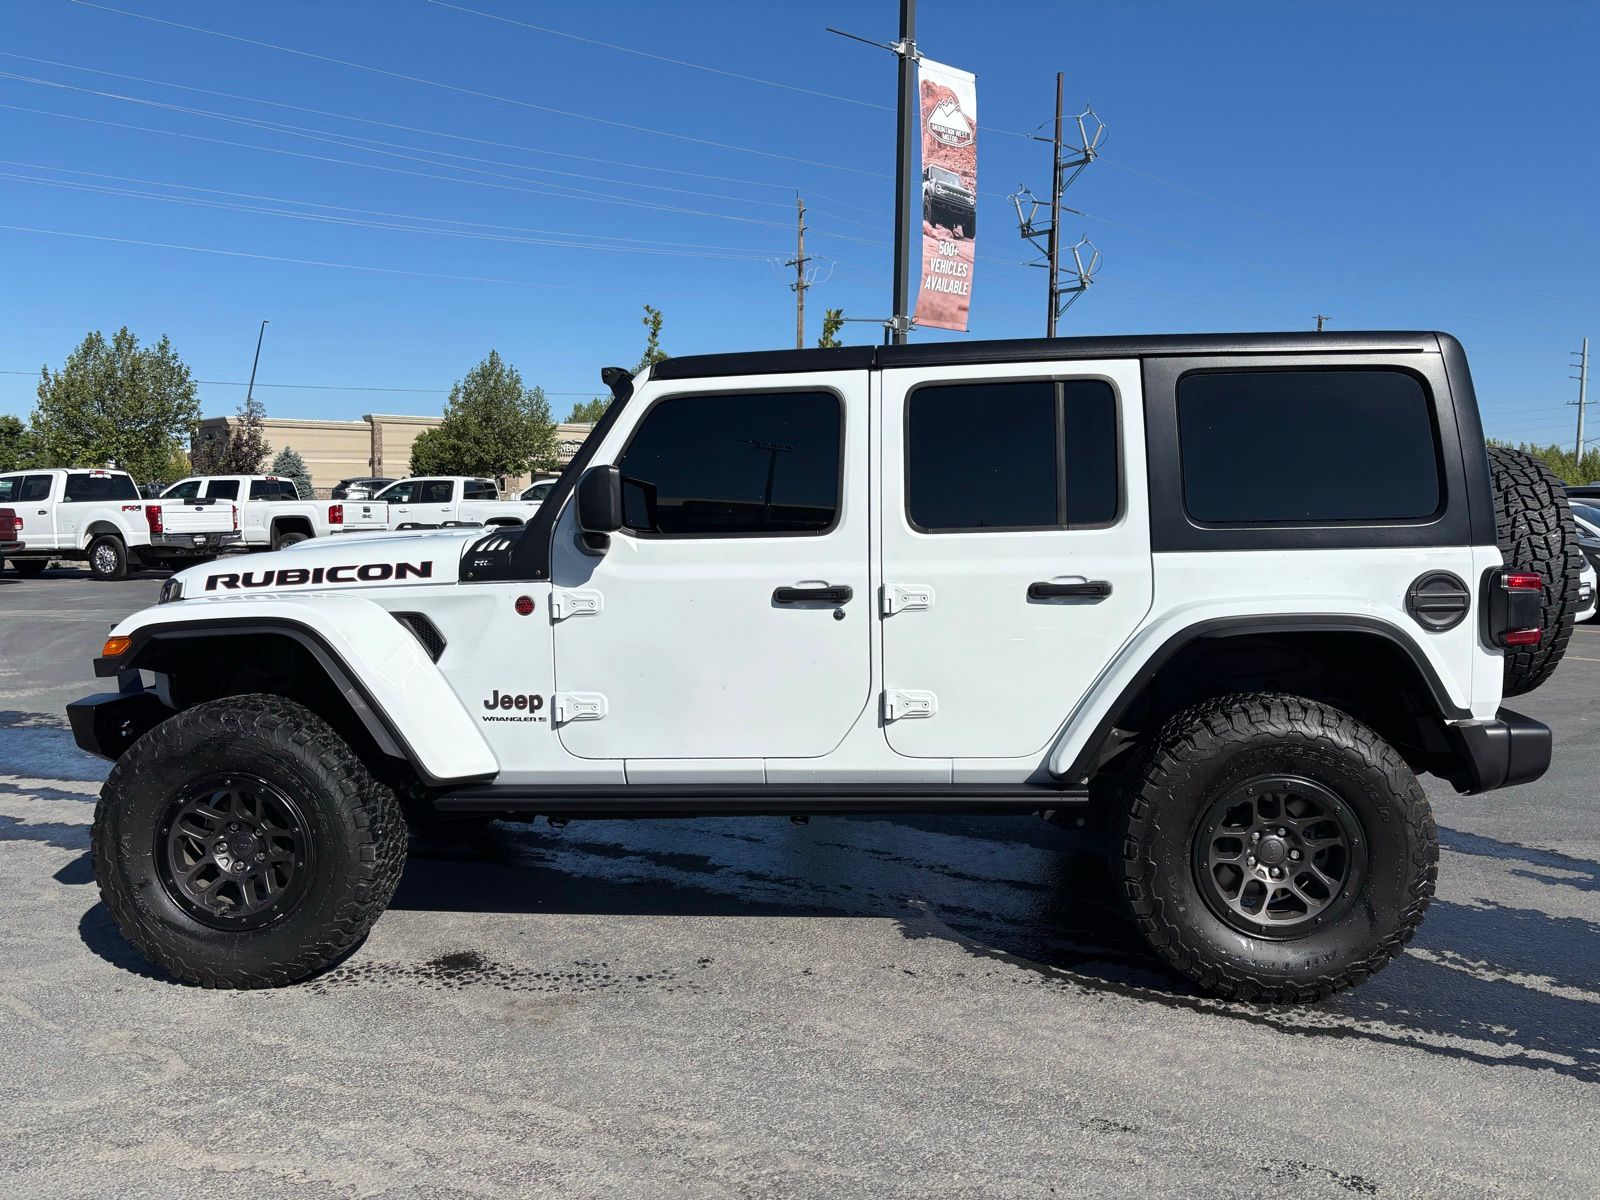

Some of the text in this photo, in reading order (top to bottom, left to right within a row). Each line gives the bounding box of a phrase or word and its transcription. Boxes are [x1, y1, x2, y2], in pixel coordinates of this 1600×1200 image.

[938, 240, 960, 257] 500+
[930, 257, 968, 277] VEHICLES
[924, 275, 969, 296] AVAILABLE
[205, 561, 433, 591] RUBICON
[483, 690, 543, 714] Jeep
